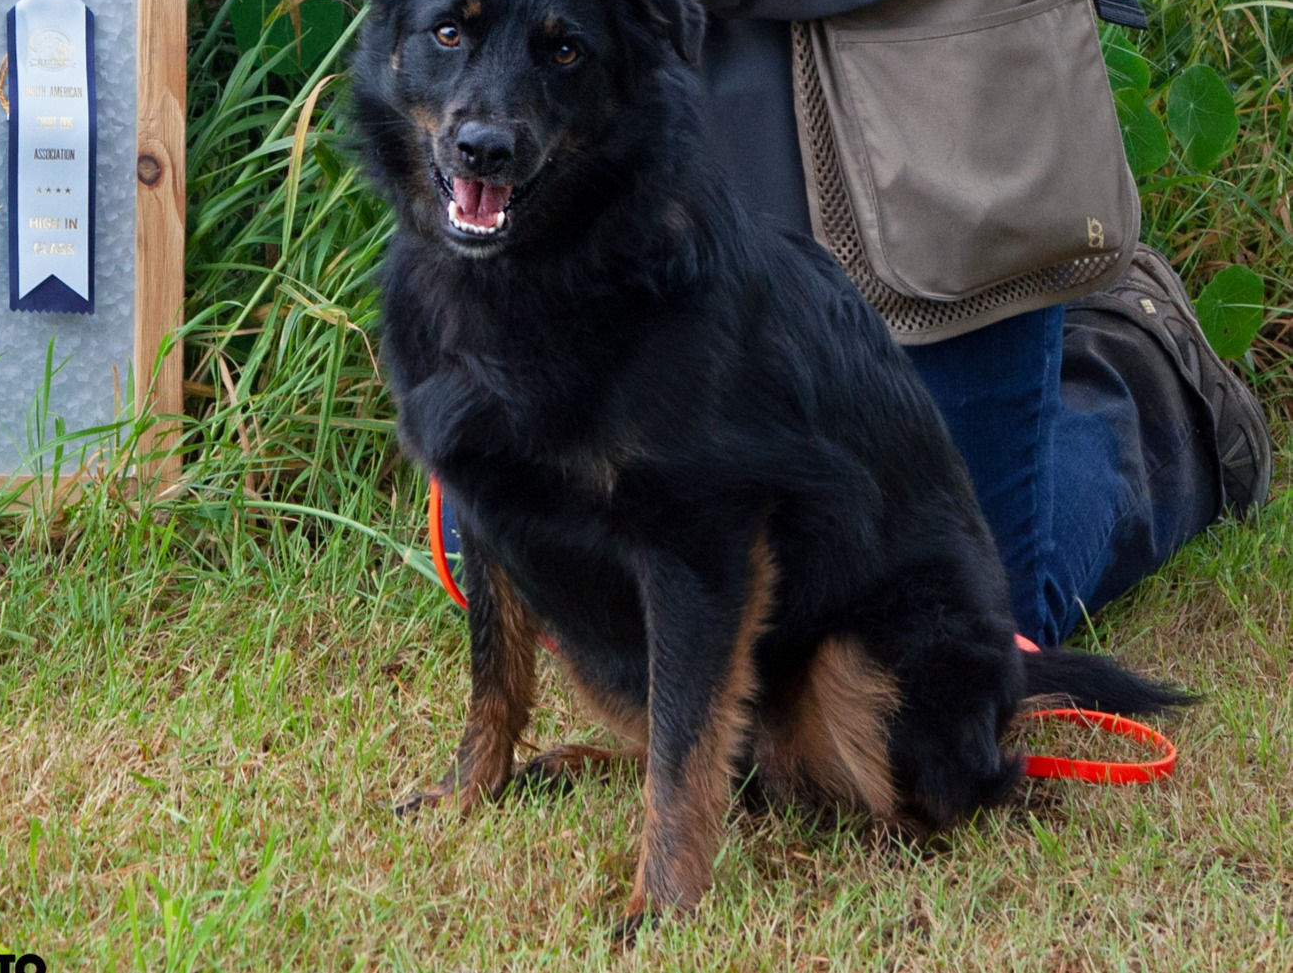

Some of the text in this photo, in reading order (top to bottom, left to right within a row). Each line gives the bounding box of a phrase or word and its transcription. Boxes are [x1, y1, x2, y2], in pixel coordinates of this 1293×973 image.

[49, 86, 83, 98] AMERICAN
[34, 148, 76, 161] ASSOCIATION
[64, 217, 79, 230] IN
